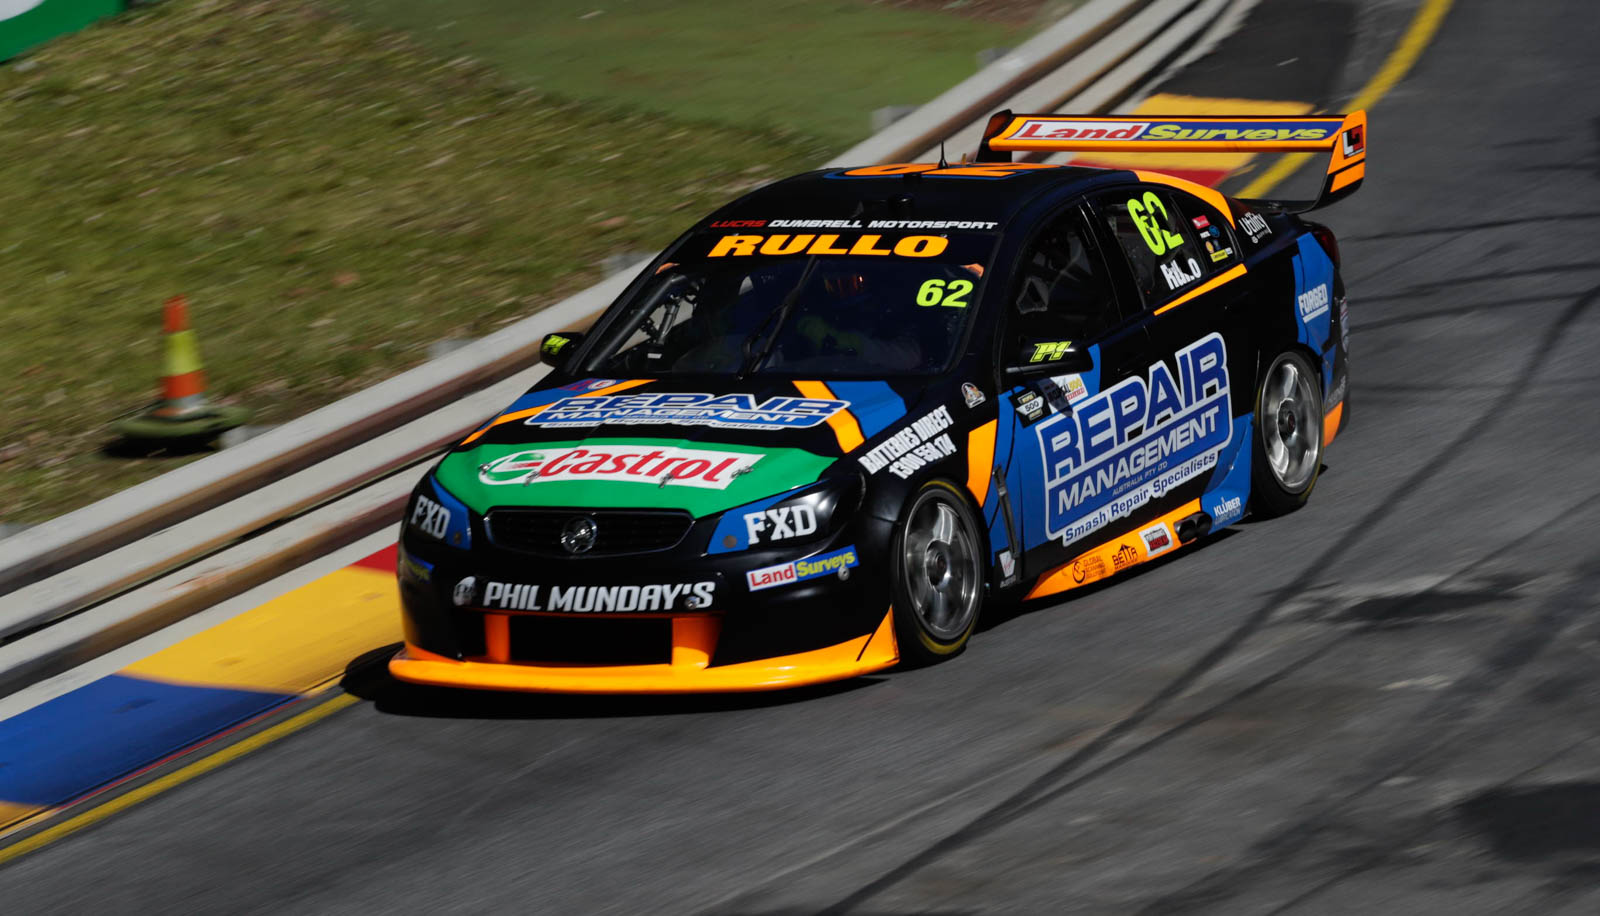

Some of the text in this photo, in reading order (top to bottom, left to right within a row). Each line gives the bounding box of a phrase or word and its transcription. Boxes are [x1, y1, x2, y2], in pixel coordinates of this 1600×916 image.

[1018, 122, 1328, 142] Land Surveys
[709, 219, 999, 230] LUCAS DUMBRELL MOTORSPORT
[1126, 191, 1185, 256] 62
[706, 234, 950, 258] RULLO
[1159, 257, 1202, 290] RUO
[915, 279, 975, 308] 62
[1298, 283, 1329, 316] FORGED
[546, 407, 808, 423] MANAGEMENT
[548, 394, 845, 415] REPAIR
[1024, 400, 1040, 413] 500
[1038, 335, 1229, 484] REPAIR
[857, 404, 954, 475] BATTERIES DIRECT
[539, 449, 739, 482] Castrol
[889, 452, 927, 480] 1300
[1058, 405, 1220, 515] MANAGEMENT
[1065, 511, 1107, 543] Smash
[1111, 488, 1149, 518] Repair
[1152, 453, 1216, 493] Specialists
[1112, 475, 1143, 498] AUSTRALIA
[1144, 469, 1159, 484] PTY
[743, 504, 817, 545] FXD
[750, 551, 856, 587] Land Surveys
[1112, 544, 1138, 566] BETTA
[483, 581, 716, 613] PHIL MUNDAY'S
